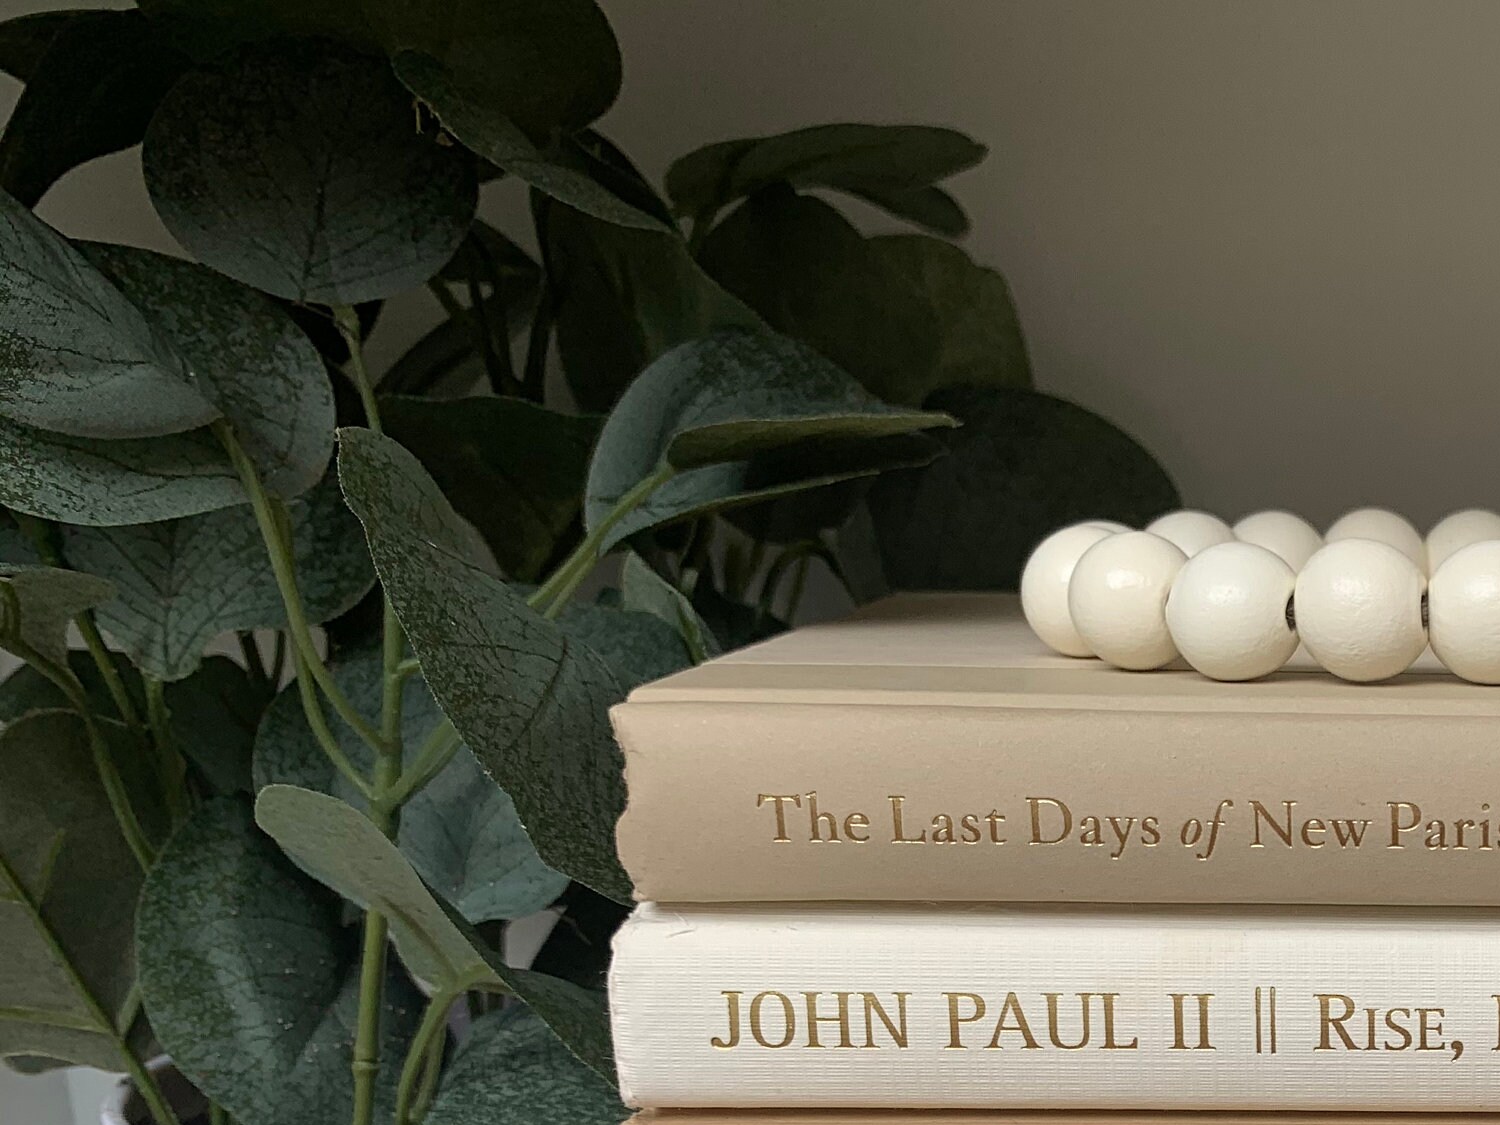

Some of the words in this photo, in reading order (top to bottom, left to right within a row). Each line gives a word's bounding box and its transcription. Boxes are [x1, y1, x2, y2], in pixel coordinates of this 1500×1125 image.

[757, 790, 870, 844] The
[889, 795, 1008, 845] Last
[1025, 797, 1160, 859] Days
[1180, 800, 1234, 859] of
[1249, 801, 1371, 849] New
[711, 990, 911, 1050] JOHN
[941, 992, 1138, 1051] PAUL
[1167, 993, 1217, 1051] II
[1313, 993, 1465, 1063] RISE,
